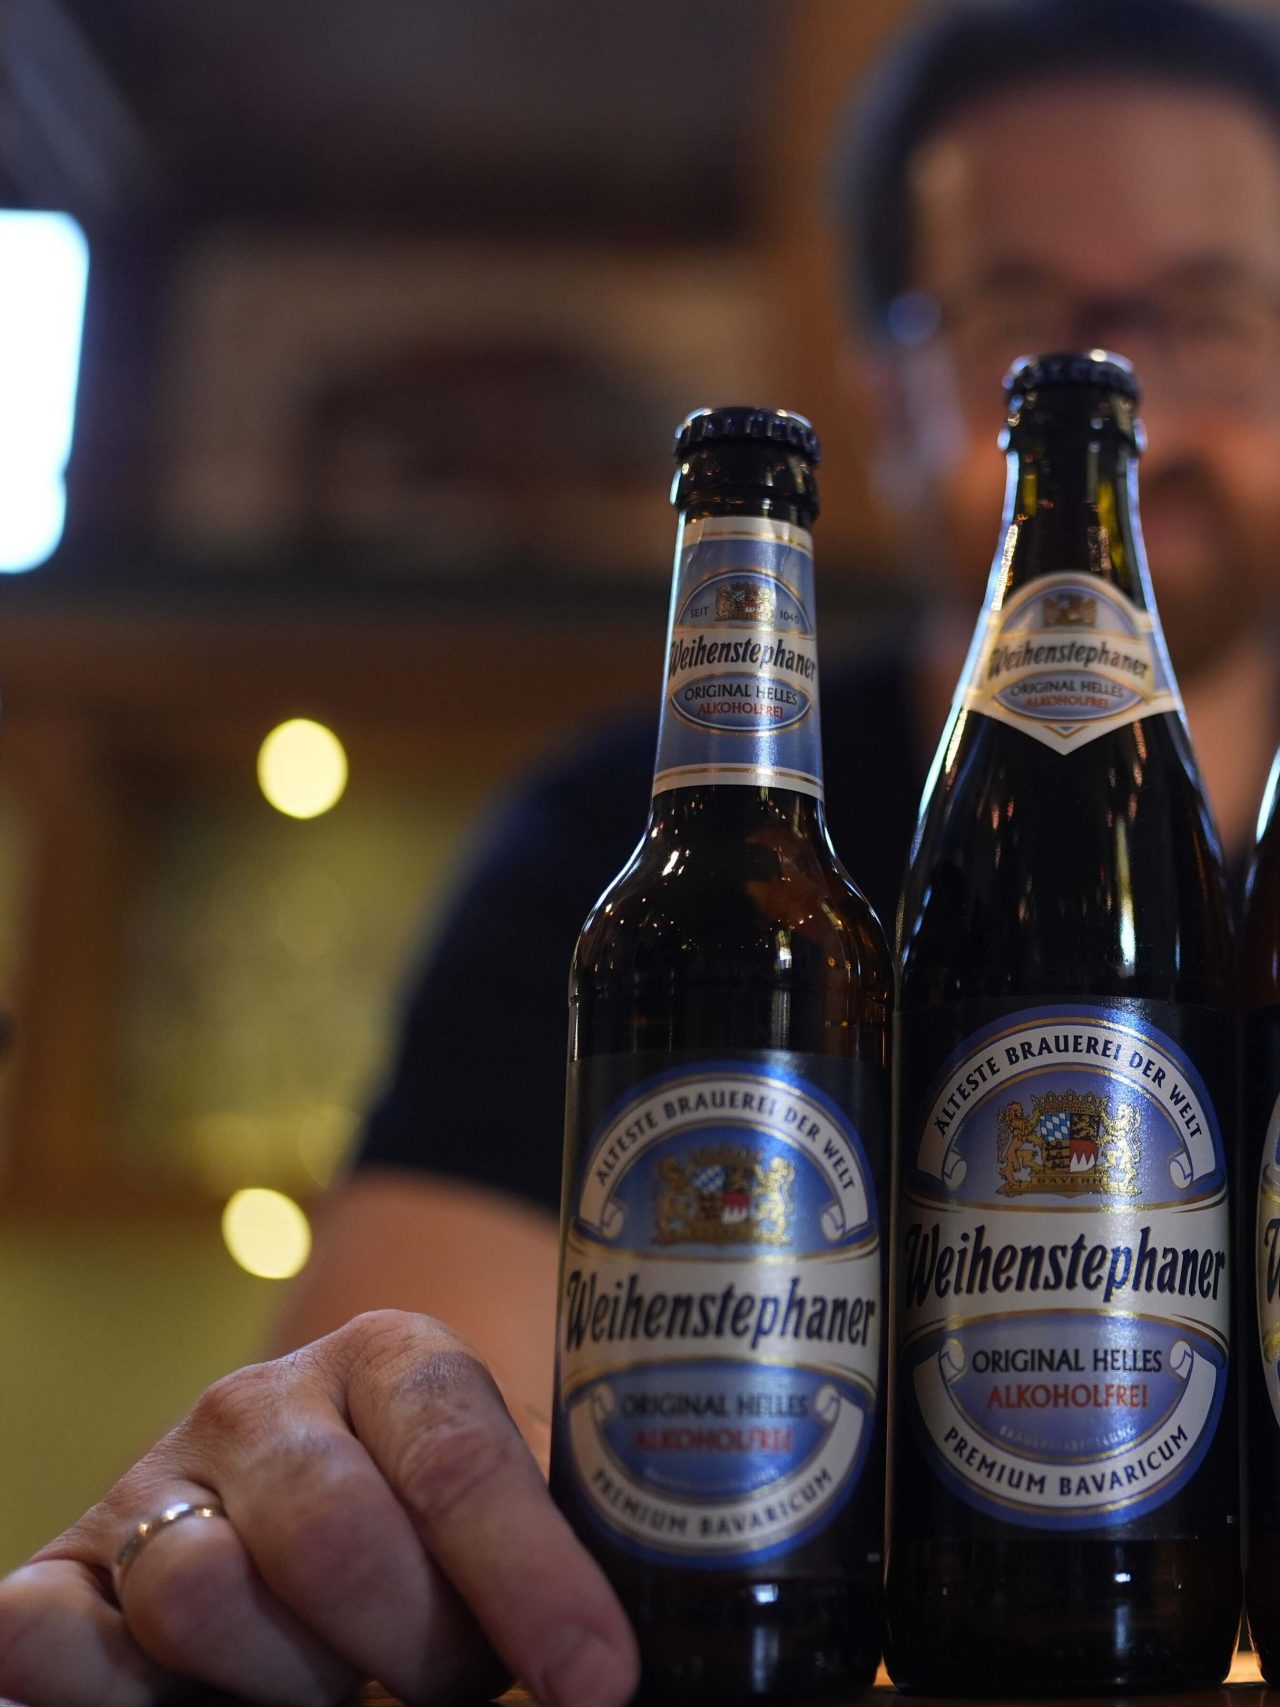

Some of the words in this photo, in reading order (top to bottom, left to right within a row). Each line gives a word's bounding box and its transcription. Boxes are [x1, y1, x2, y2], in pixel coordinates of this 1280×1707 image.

[690, 606, 710, 618] SEIT
[779, 610, 800, 625] 1040
[668, 635, 816, 681] Weihenstephaner
[684, 684, 751, 702] ORIGINAL
[756, 685, 798, 705] HELLES
[698, 702, 783, 719] ALKOHOLFREI
[1010, 680, 1075, 697] ORIGINAL
[1081, 680, 1123, 698] HELLES
[933, 1056, 1000, 1137] ÄLTESTE
[1005, 1034, 1121, 1066] BRAUEREI
[1129, 1051, 1166, 1089] DER
[1169, 1083, 1203, 1138] WELT
[663, 1089, 776, 1119] BRAUEREI
[786, 1107, 821, 1140] DER
[823, 1139, 855, 1190] WELT
[906, 1223, 1225, 1310] Weihenstephaner
[566, 1270, 876, 1349] Weihenstephaner
[972, 1349, 1085, 1373] ORIGINAL
[1093, 1349, 1162, 1373] HELLES
[987, 1383, 1148, 1408] ALKOHOLFREI
[945, 1425, 1046, 1494] PREMIUM
[1059, 1424, 1188, 1496] BAVARICUM
[592, 1469, 688, 1534] PREMIUM
[701, 1466, 832, 1537] BAVARICUM
